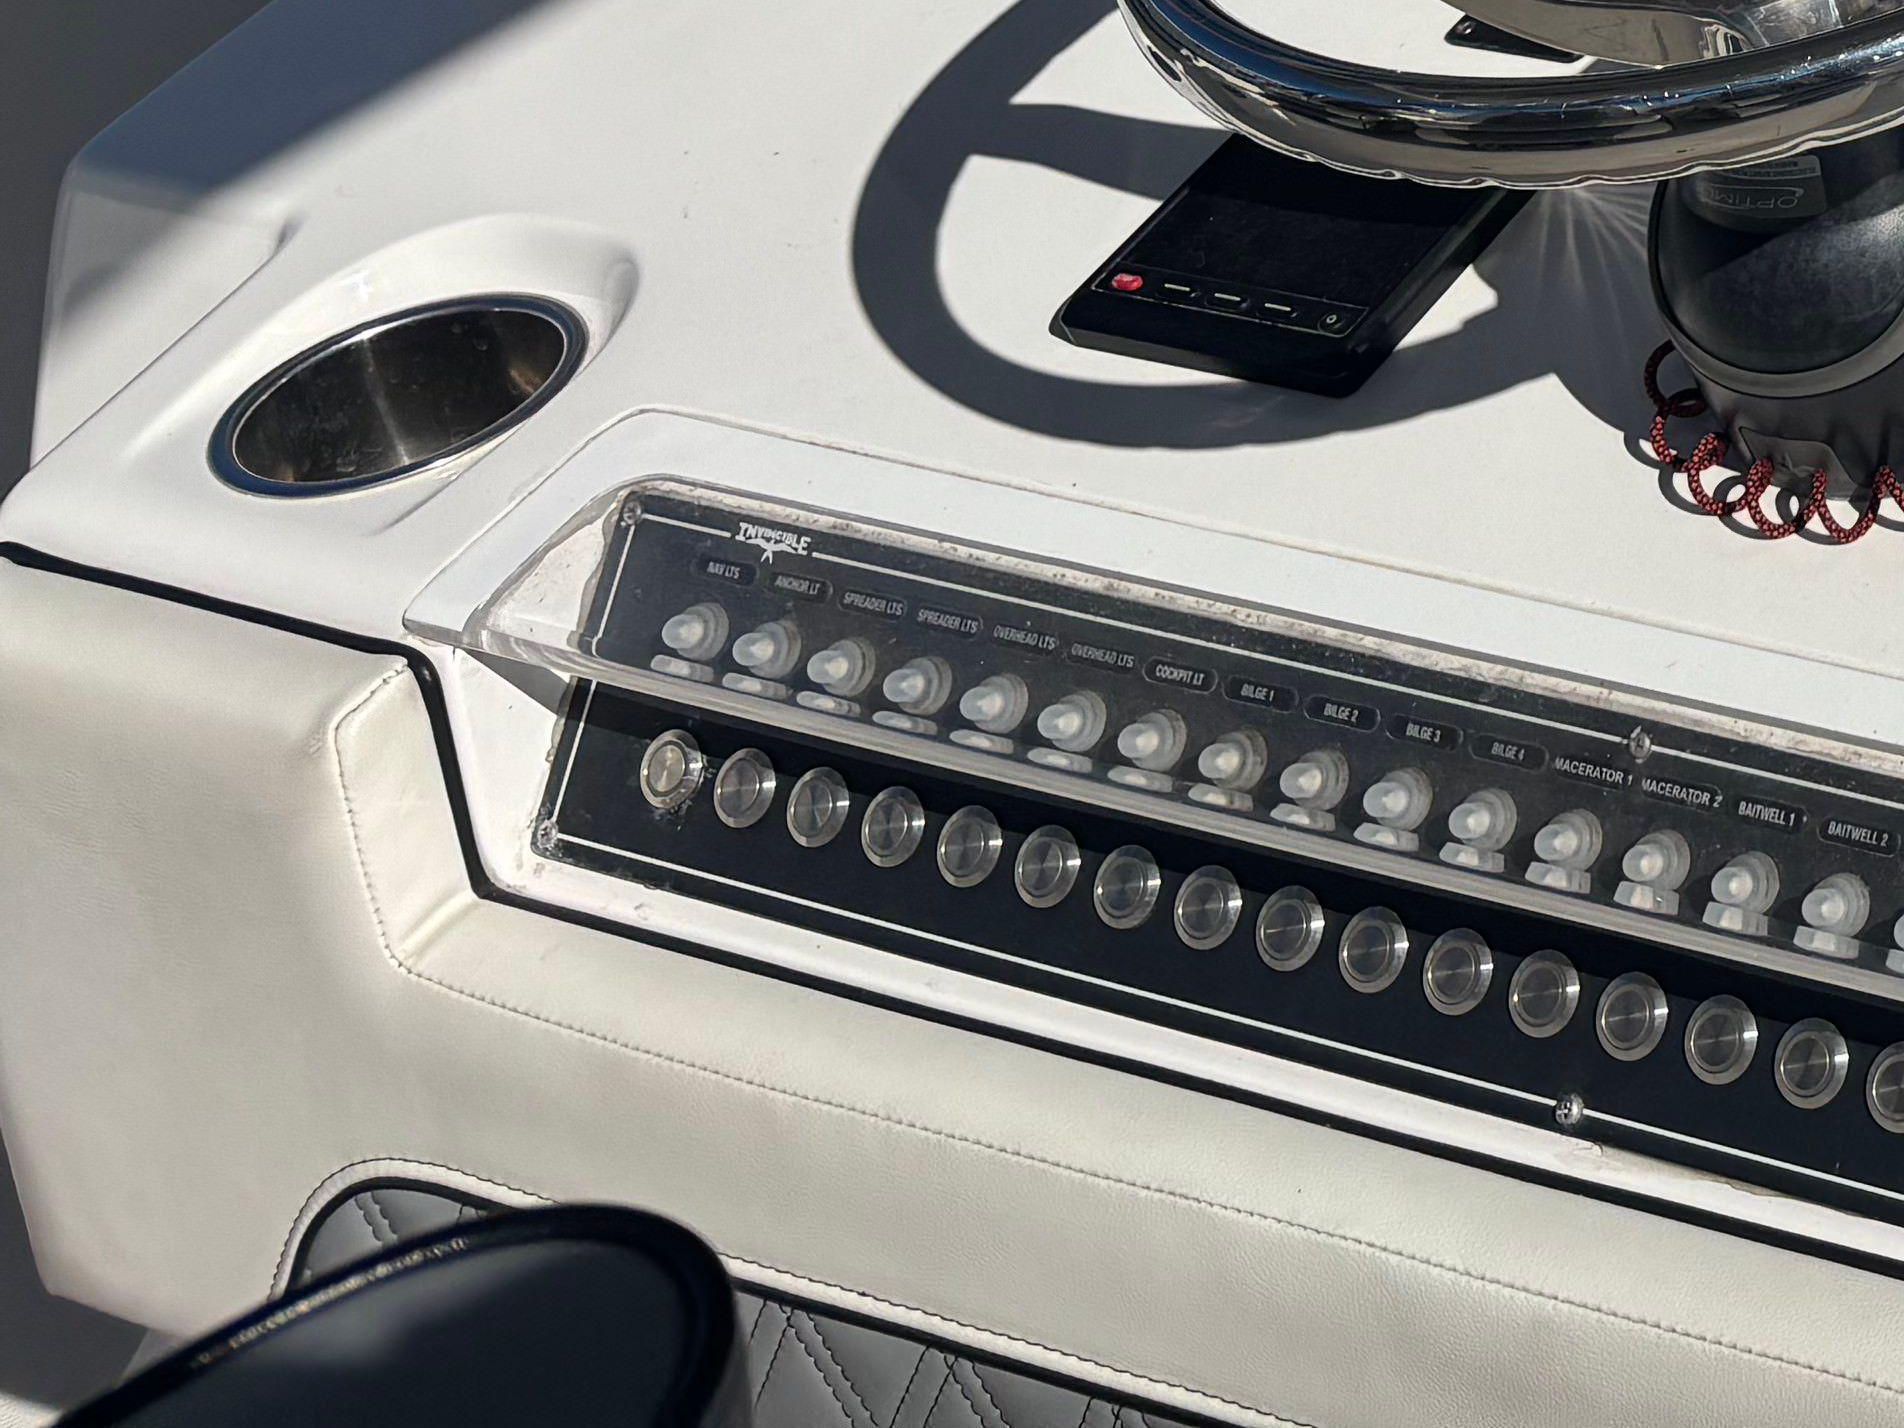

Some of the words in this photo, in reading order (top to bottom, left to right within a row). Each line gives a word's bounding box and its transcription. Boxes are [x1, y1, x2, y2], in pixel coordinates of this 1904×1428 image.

[735, 522, 812, 555] INVINCIBLE
[725, 564, 740, 579] LTS
[843, 592, 886, 612] SPREADER
[886, 601, 904, 615] LTS
[918, 609, 961, 630] SPREADER
[961, 618, 979, 633] LTS
[993, 625, 1038, 646] OVERHEAD
[1038, 634, 1056, 650] LTS
[1071, 643, 1117, 664] OVERHEAD
[1117, 653, 1135, 667] LTS
[1155, 664, 1192, 682] COCKPIT
[1192, 672, 1205, 685] LT
[1241, 684, 1267, 700] BILGE
[1268, 690, 1274, 702] 1
[1324, 703, 1350, 721] BILGE
[1351, 710, 1359, 723] 2
[1406, 723, 1433, 741] BILGE
[1433, 729, 1441, 742] 3
[1491, 742, 1518, 759] BILGE
[1554, 757, 1624, 784] MACERATOR
[1626, 775, 1633, 786] 1
[1641, 778, 1711, 805] MACERATOR
[1712, 794, 1723, 808] 2
[1738, 801, 1787, 824] BAITWELL
[1789, 813, 1796, 826] 1
[1828, 821, 1878, 844] BAITWELL
[1880, 833, 1889, 847] 2
